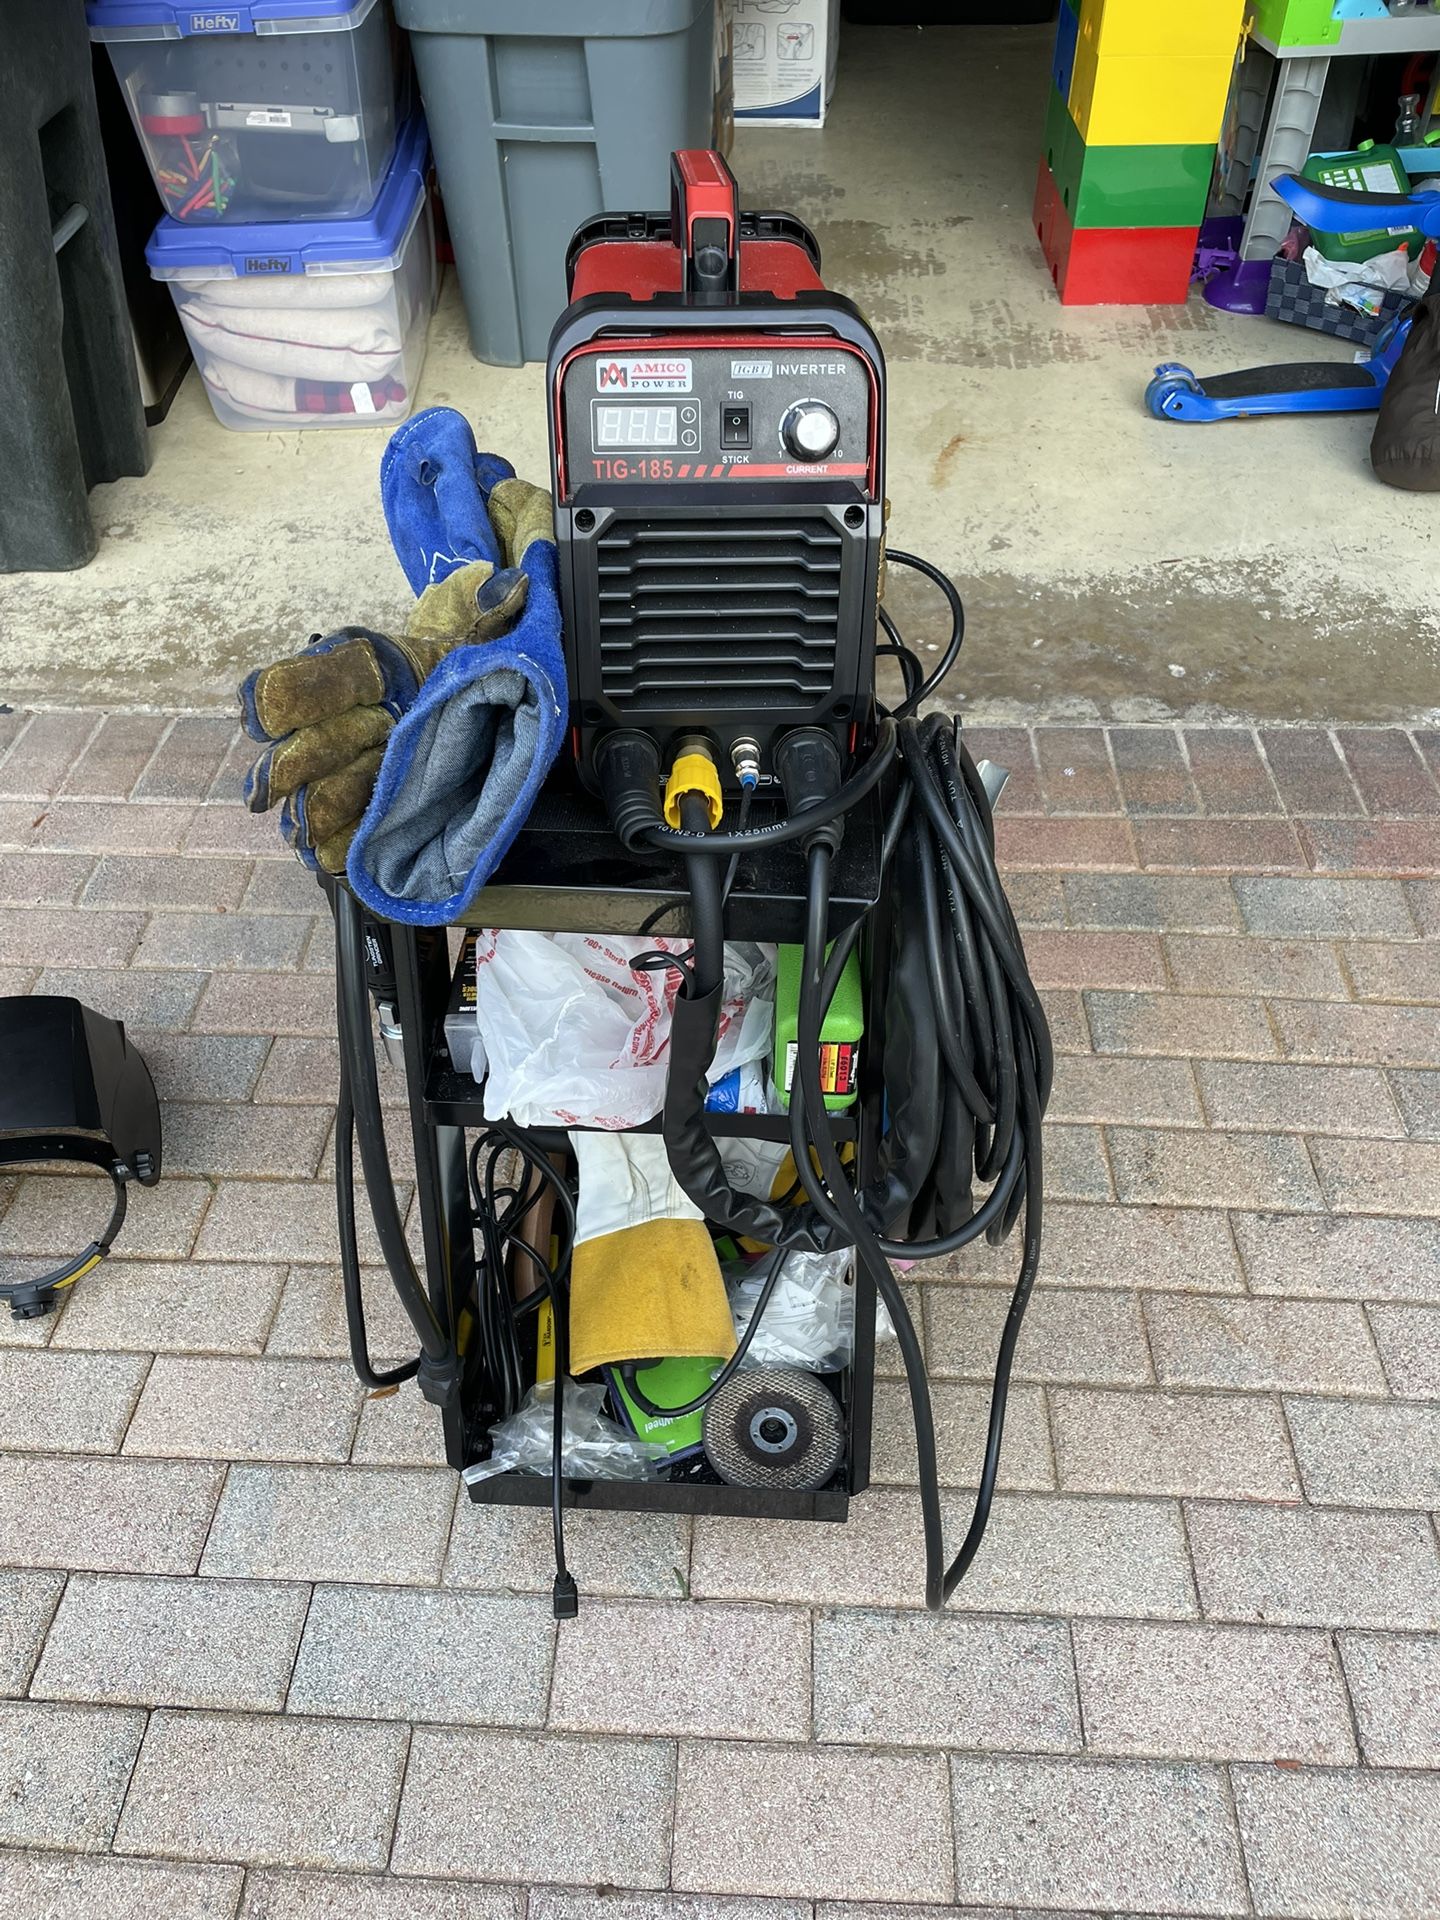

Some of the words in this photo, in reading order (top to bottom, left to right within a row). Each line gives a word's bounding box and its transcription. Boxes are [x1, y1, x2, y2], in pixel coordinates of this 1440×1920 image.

[193, 15, 237, 30] Hefty
[248, 259, 288, 272] Hefty
[632, 363, 686, 373] AMICO
[776, 364, 846, 375] INVERTER
[631, 380, 686, 388] POWER
[728, 391, 744, 399] TIG
[722, 456, 750, 464] STICK
[592, 459, 673, 479] TIG-185
[786, 465, 828, 474] CURRENT
[583, 937, 603, 951] 700+
[645, 1417, 674, 1433] Wheel
